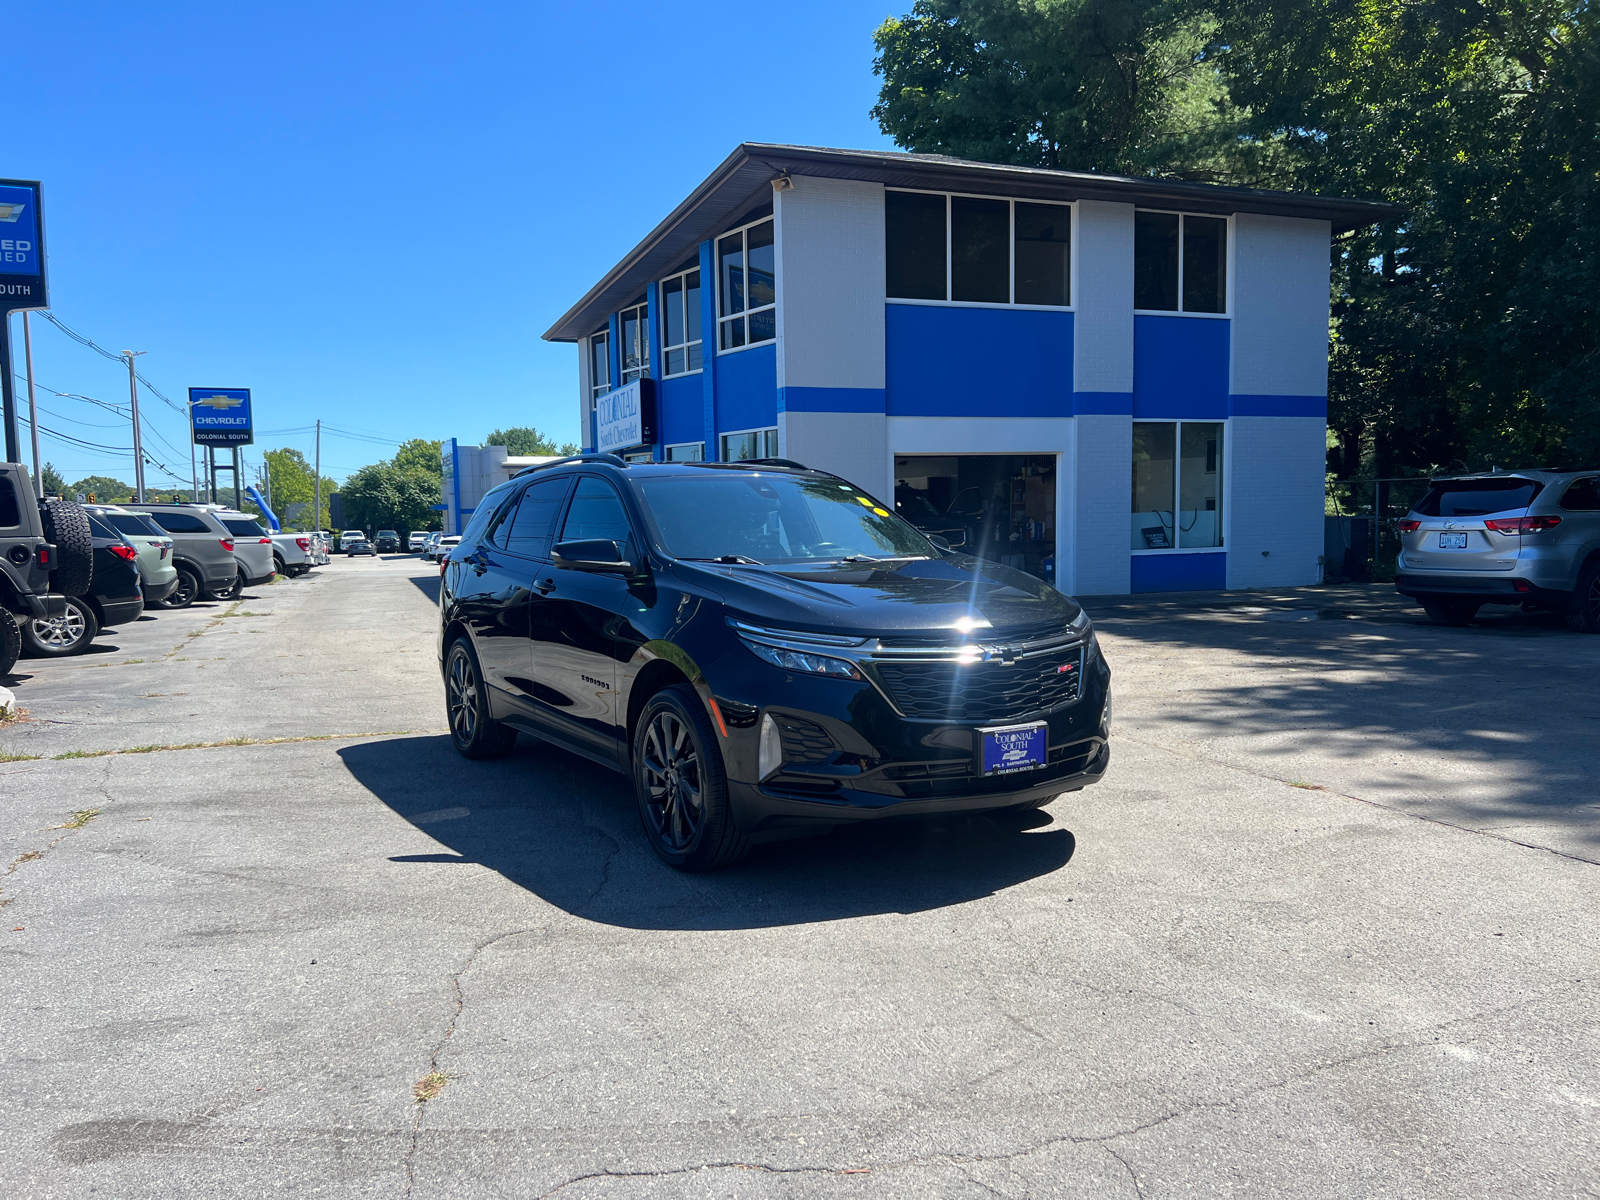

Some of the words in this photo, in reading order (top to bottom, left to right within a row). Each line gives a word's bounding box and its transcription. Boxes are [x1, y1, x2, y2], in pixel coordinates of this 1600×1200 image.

[600, 388, 637, 427] COLONIAL
[196, 417, 247, 425] CHEVROLET
[600, 428, 613, 448] South
[613, 421, 637, 444] Chevrolet
[1454, 536, 1465, 545] 259
[581, 674, 610, 690] EQUINOX
[995, 732, 1034, 744] COLONIAL
[1001, 740, 1028, 751] SOUTH
